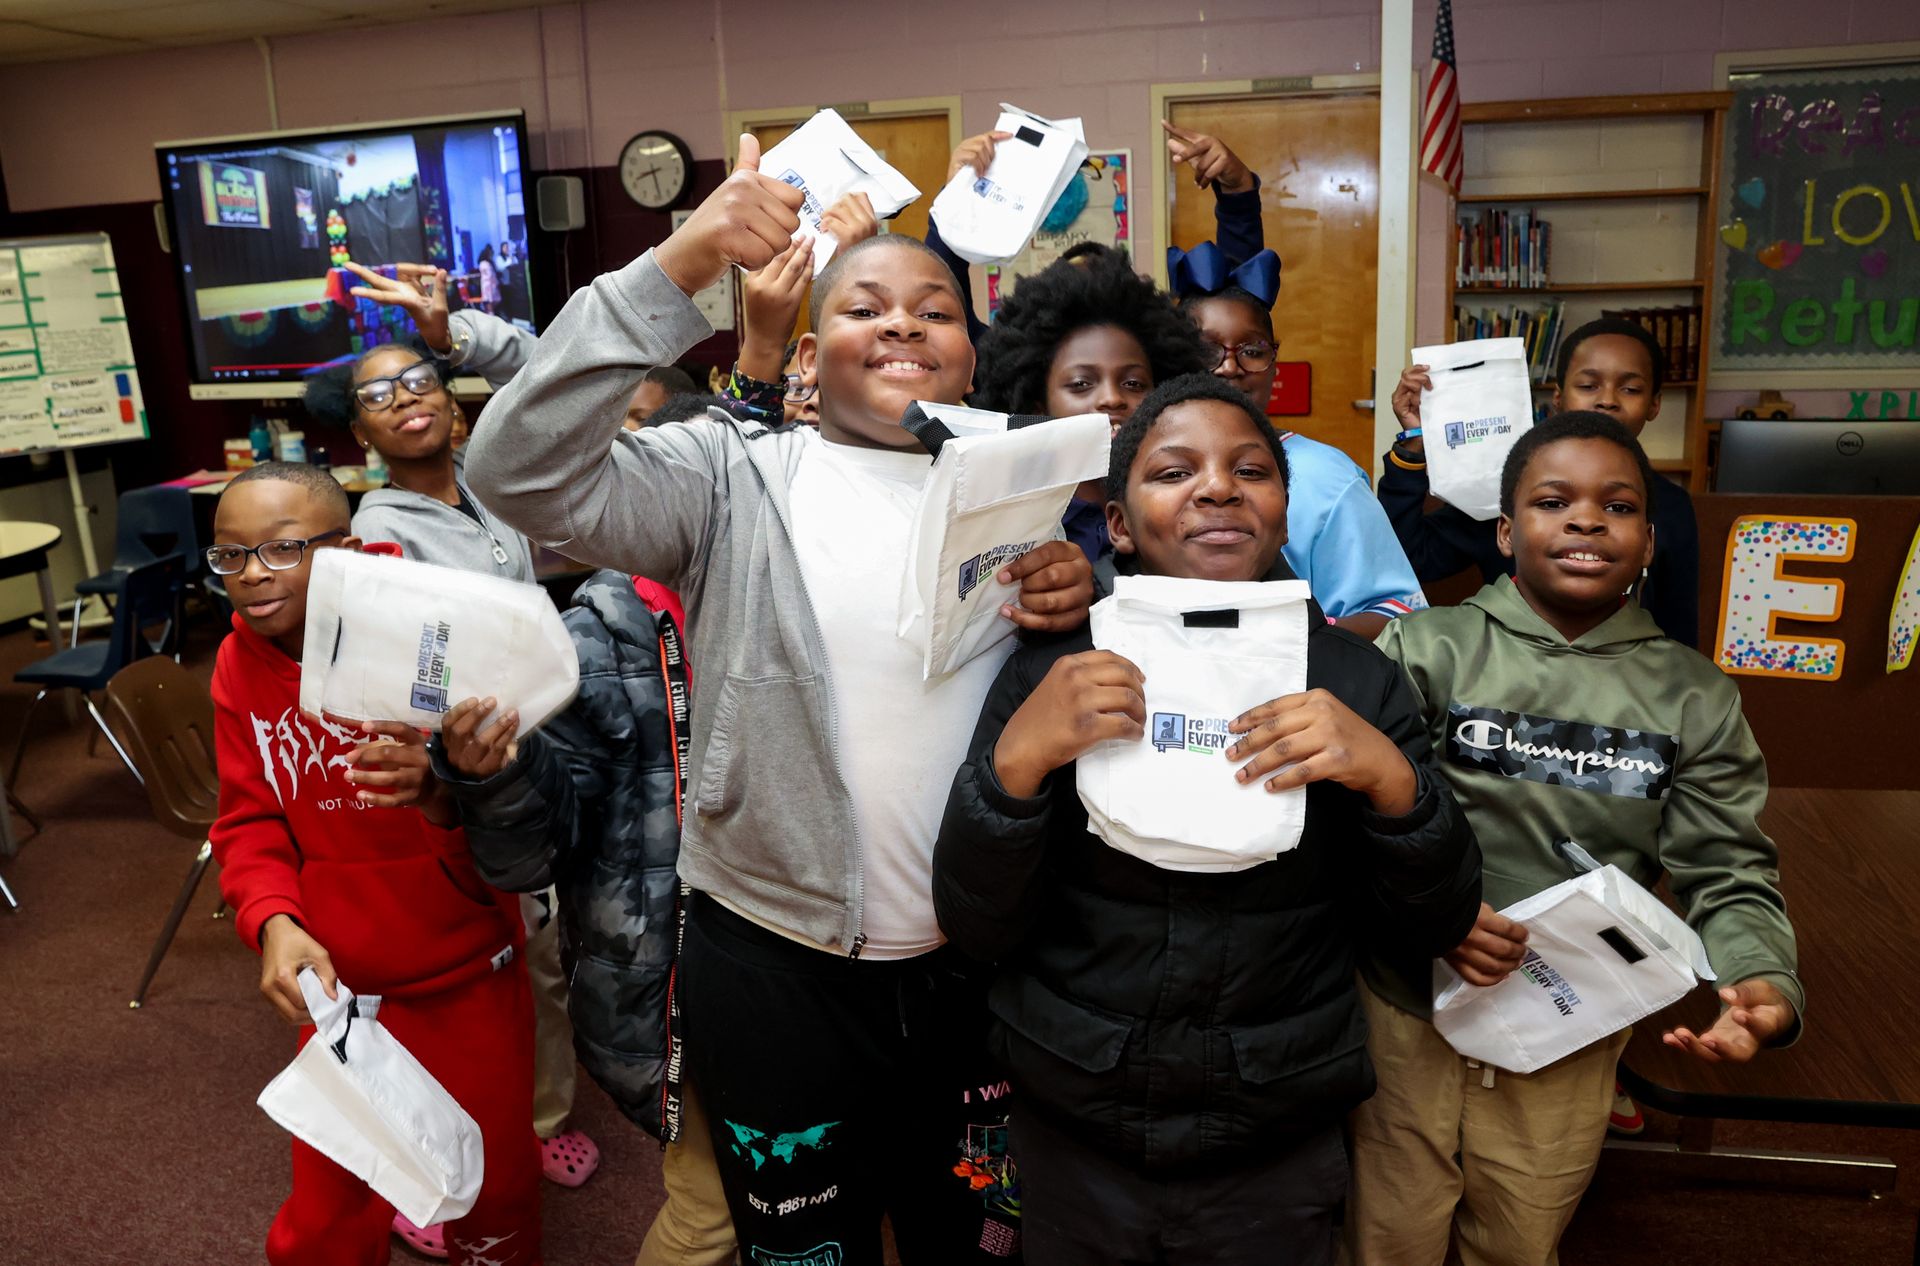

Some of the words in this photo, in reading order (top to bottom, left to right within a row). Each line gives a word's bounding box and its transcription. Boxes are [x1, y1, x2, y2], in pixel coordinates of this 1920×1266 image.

[1465, 416, 1507, 430] rePRESENT
[1466, 427, 1490, 439] EVERY
[1497, 424, 1511, 434] DAY
[980, 540, 1037, 564] rePRESENT
[979, 554, 1006, 577] EVERY
[436, 620, 451, 643] DAY
[416, 622, 437, 683] rePRESENT
[428, 653, 445, 686] EVERY
[1188, 717, 1229, 733] rePRE
[1188, 731, 1227, 749] EVERY
[1456, 719, 1666, 776] Champion
[317, 797, 342, 811] NOT
[1525, 963, 1554, 988] EVERY
[1553, 996, 1574, 1017] DAY
[1535, 960, 1582, 1007] rePRESENT
[667, 1034, 683, 1084] HURLEY
[963, 1090, 971, 1104] I
[748, 1192, 772, 1215] EST.
[777, 1196, 807, 1216] 1987
[809, 1185, 838, 1205] NYC
